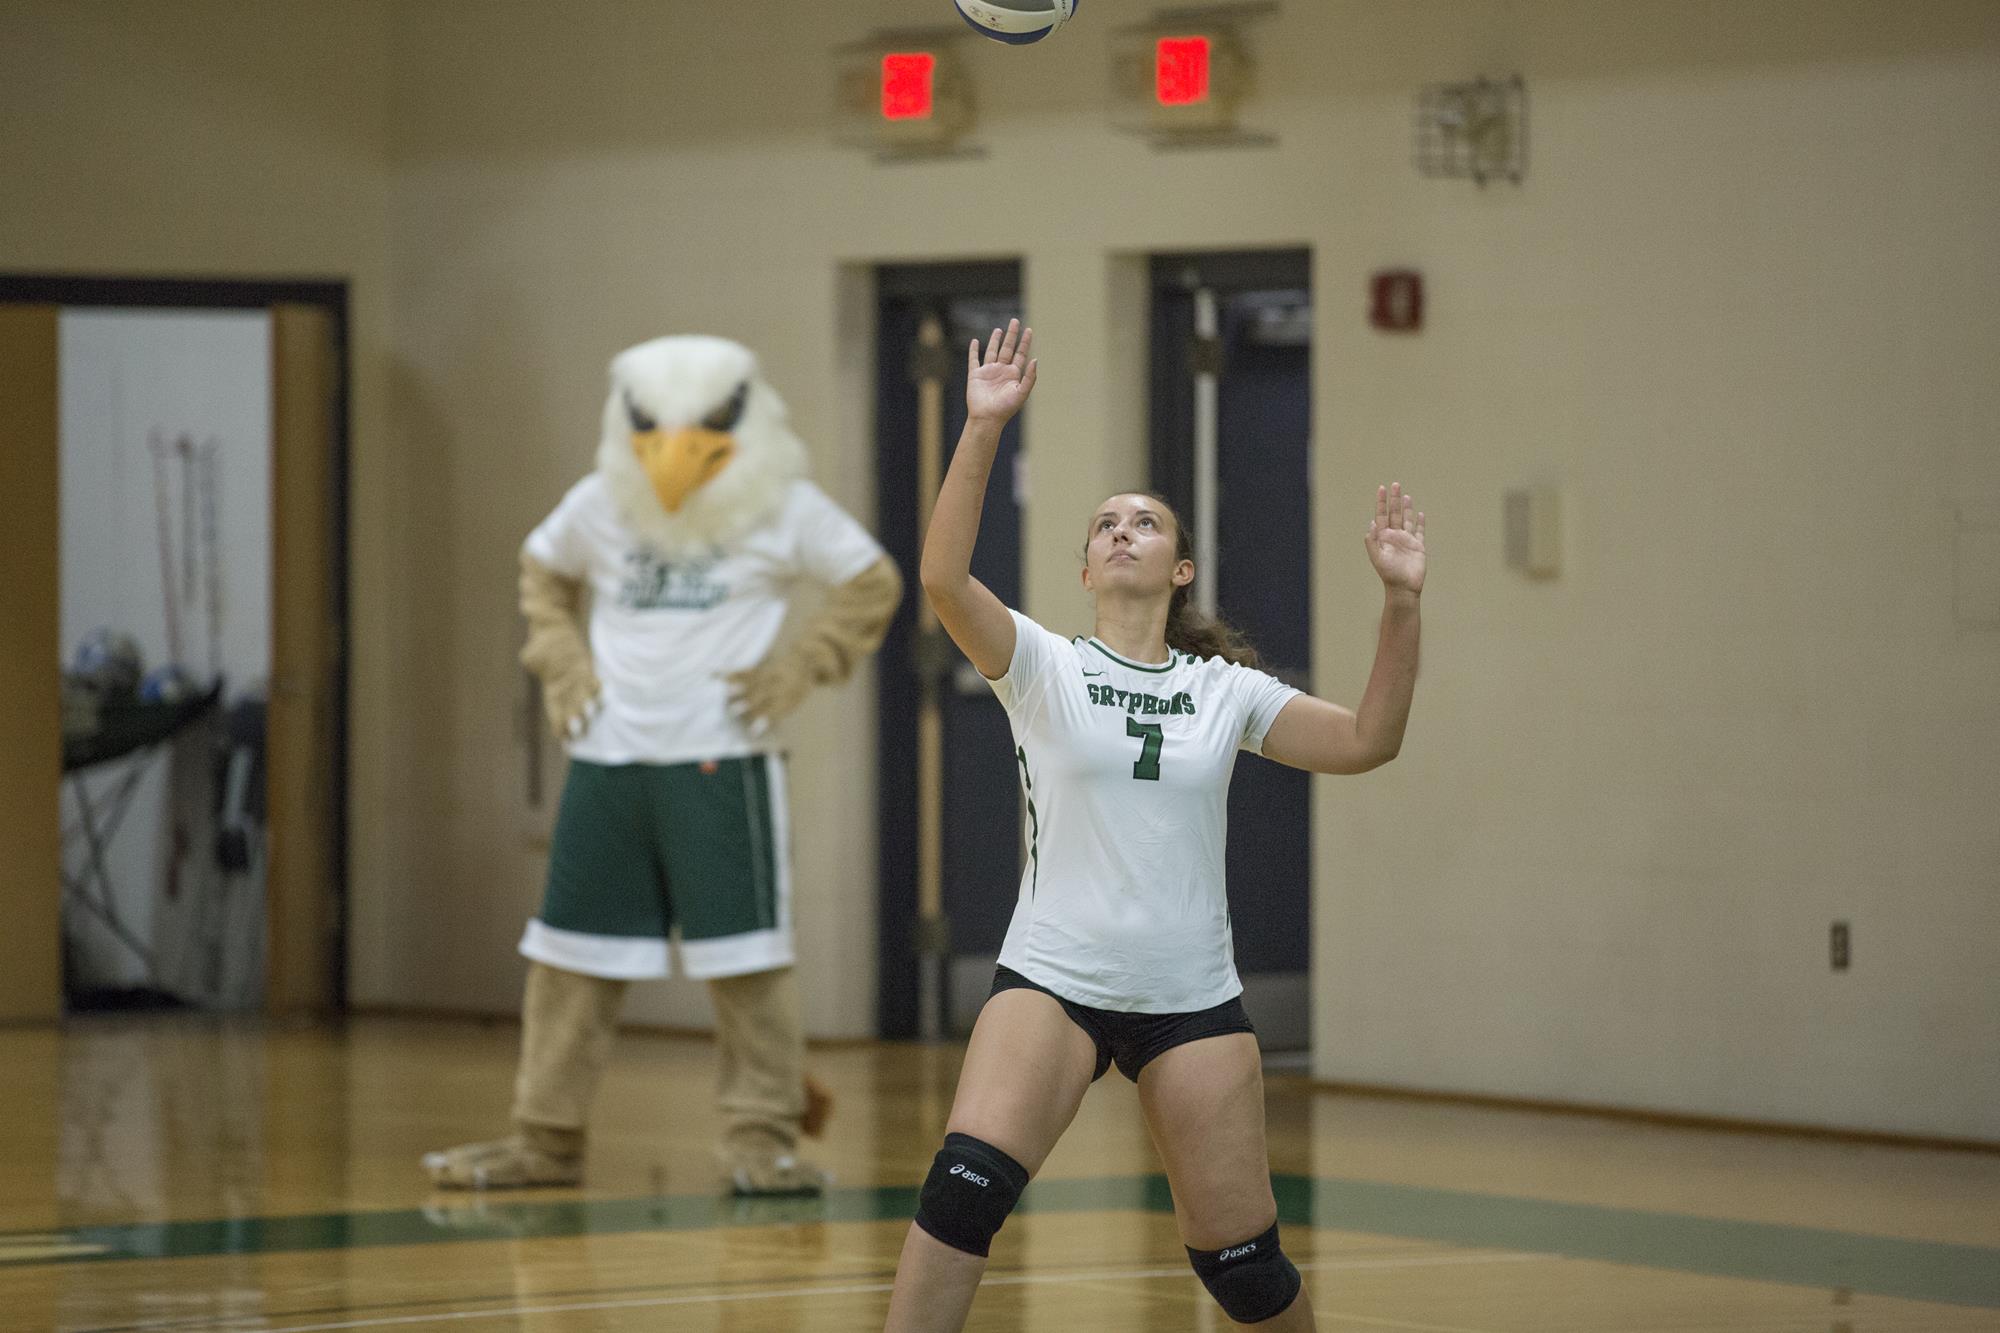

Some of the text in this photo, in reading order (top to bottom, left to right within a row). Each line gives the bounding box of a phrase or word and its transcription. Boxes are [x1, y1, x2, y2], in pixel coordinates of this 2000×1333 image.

[1087, 684, 1196, 715] GRYPHONS
[1126, 717, 1164, 781] 7
[961, 1170, 990, 1187] asics
[1230, 1242, 1256, 1258] asics
